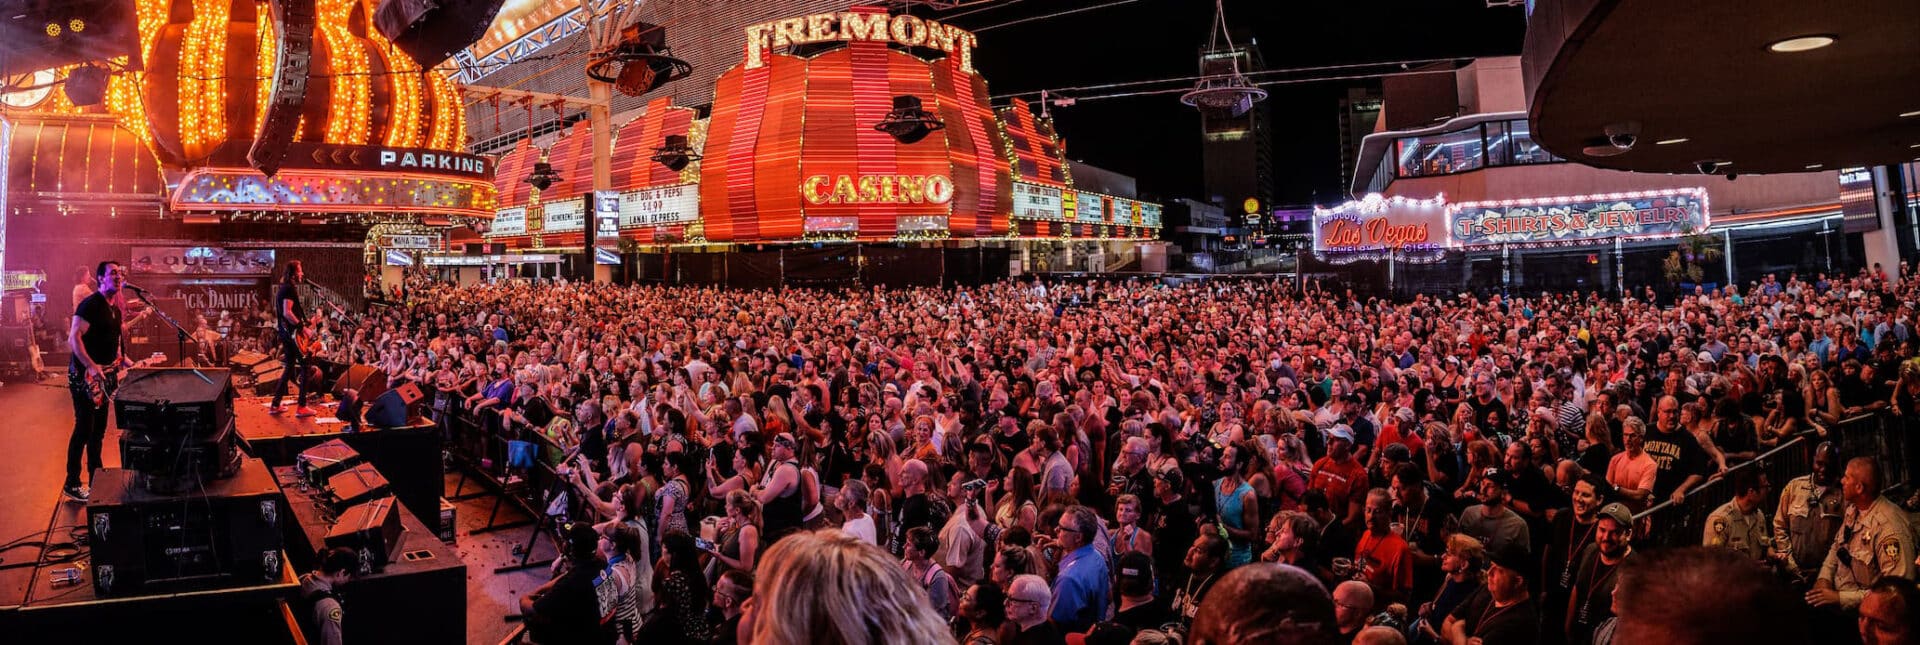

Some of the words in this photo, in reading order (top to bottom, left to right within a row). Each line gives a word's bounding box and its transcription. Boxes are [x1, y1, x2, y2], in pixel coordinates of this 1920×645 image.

[744, 11, 977, 75] FREMONT
[380, 150, 484, 174] PARKING
[626, 193, 638, 203] HOT
[641, 191, 653, 201] DOG
[656, 190, 661, 199] &
[664, 187, 683, 198] PEPSI
[803, 174, 954, 205] CASINO
[629, 213, 648, 225] LANAI
[650, 212, 681, 223] EXPRESS
[1320, 212, 1363, 228] FABULOUS
[1459, 214, 1565, 237] T-SHIRTS
[1570, 213, 1586, 230] &
[1595, 207, 1691, 230] JEWELRY
[1325, 219, 1361, 246] Las
[1366, 217, 1428, 252] Vegas
[1403, 242, 1441, 253] GIFTS
[137, 255, 153, 267] 4
[162, 254, 270, 268] QUEENS
[1644, 440, 1681, 460] MONTANA
